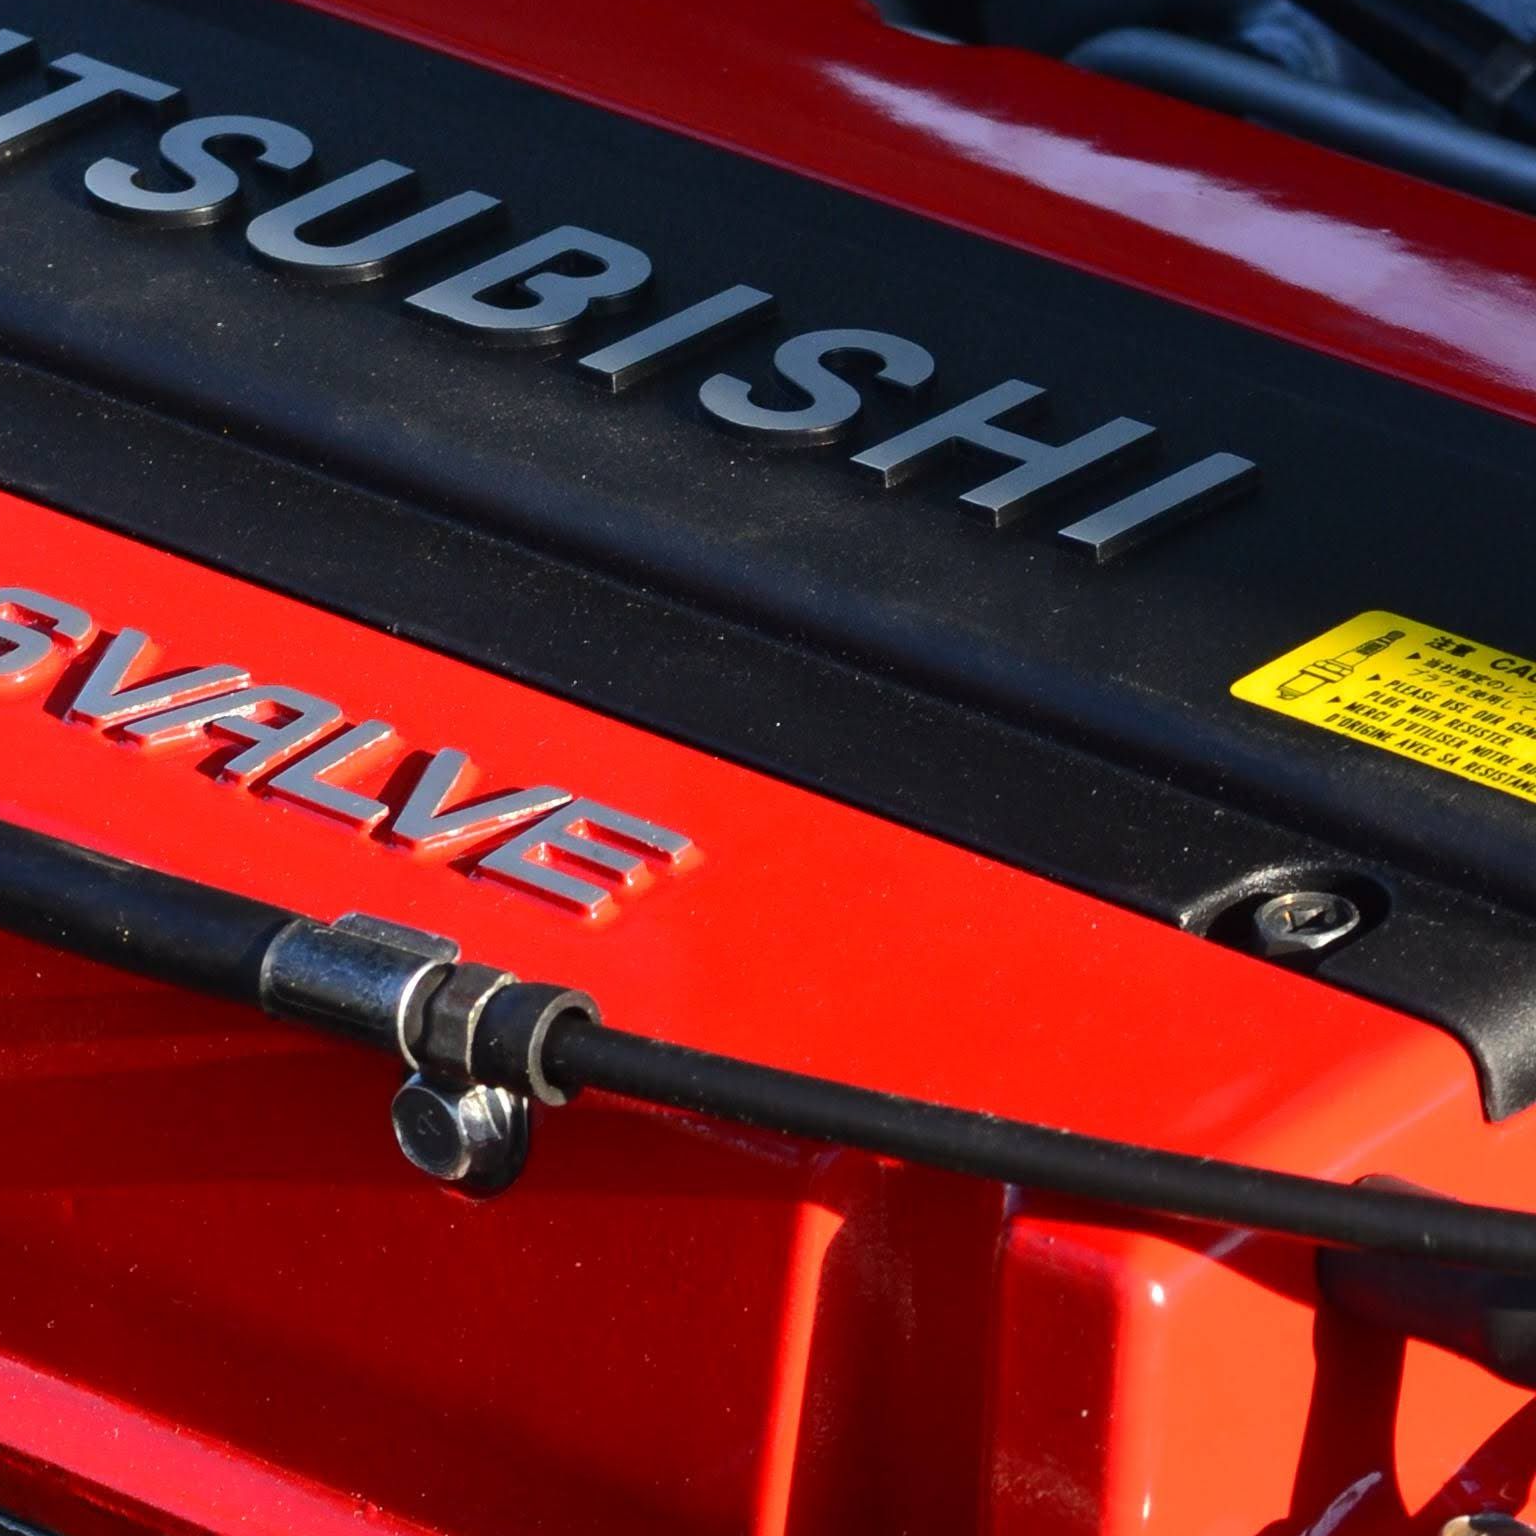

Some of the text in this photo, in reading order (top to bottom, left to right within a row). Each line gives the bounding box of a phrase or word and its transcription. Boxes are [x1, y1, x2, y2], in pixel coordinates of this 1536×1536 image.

[1364, 691, 1405, 708] PLUG
[1407, 705, 1446, 722] WITH
[1384, 680, 1440, 702] PLEASE
[1440, 699, 1472, 713] USE
[1472, 710, 1505, 725] OUR
[1324, 713, 1397, 742] D'ORIGINE
[1394, 739, 1437, 756] AVEC
[1437, 753, 1461, 765] SA
[1344, 702, 1392, 722] MERCI
[1391, 718, 1468, 749] D'UTILISER
[1468, 745, 1518, 765] NOTRE
